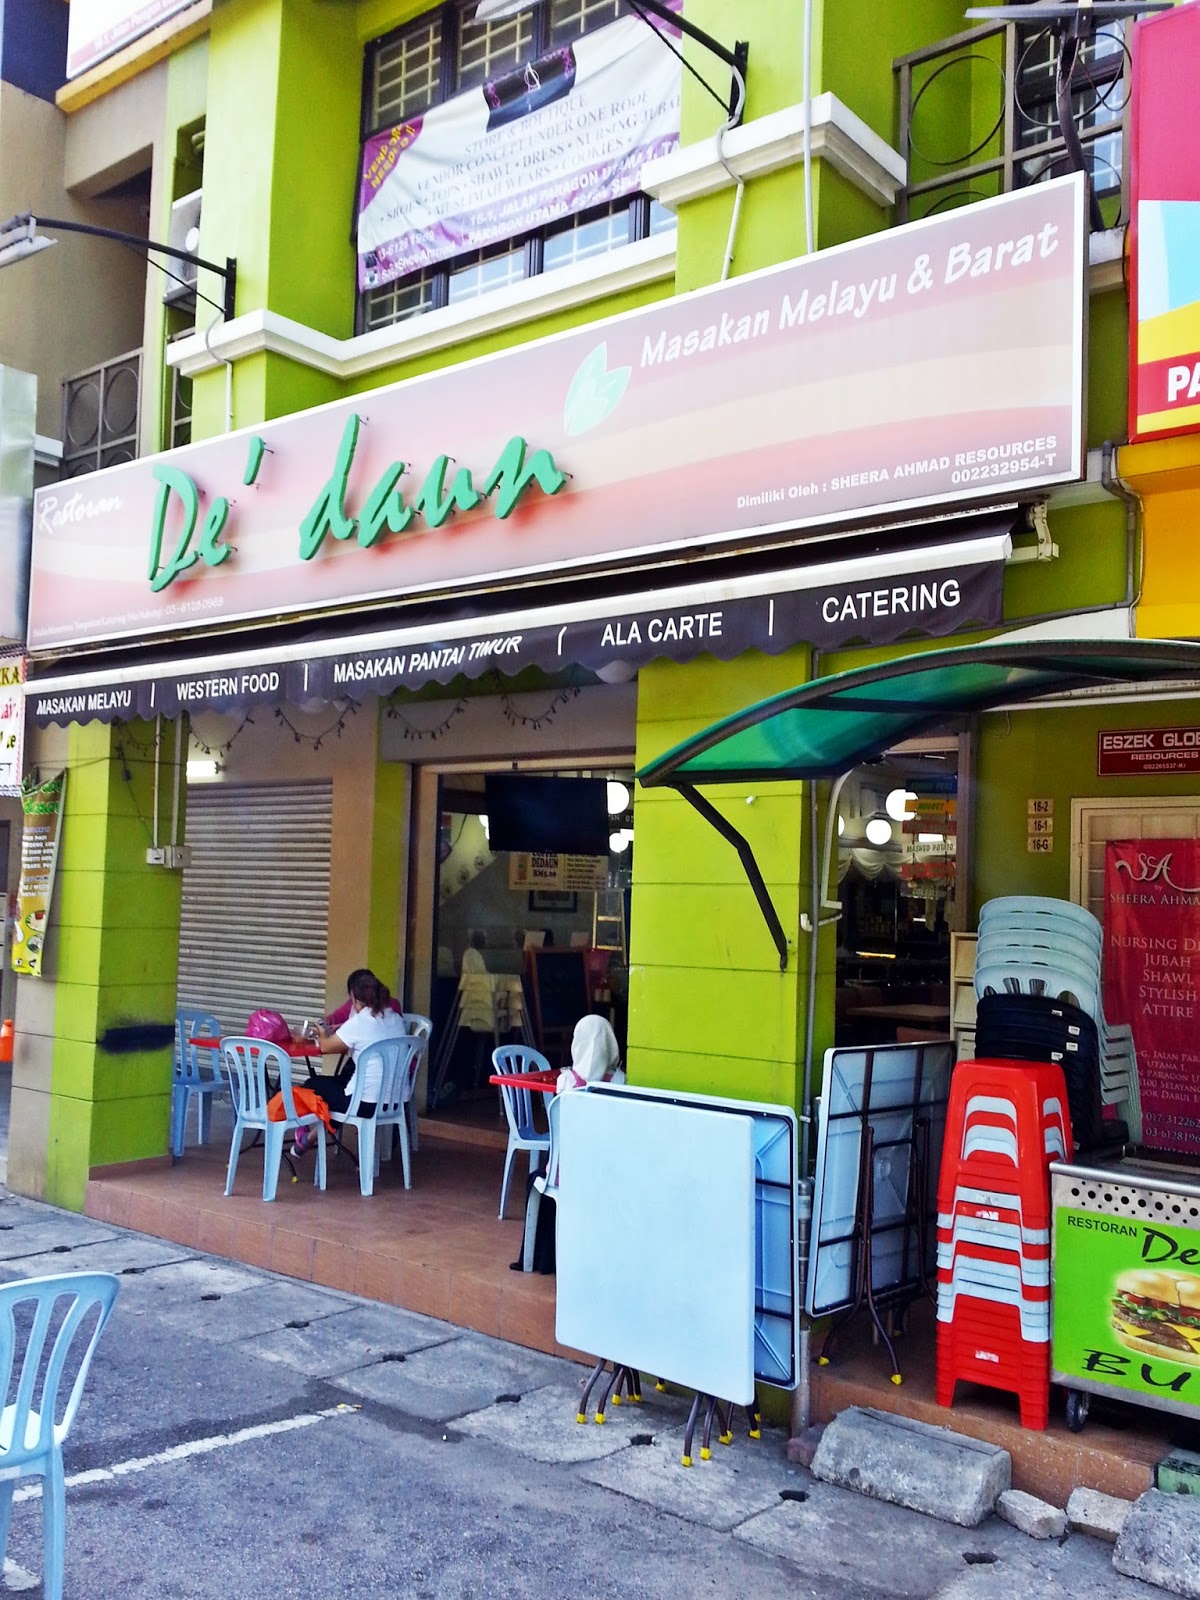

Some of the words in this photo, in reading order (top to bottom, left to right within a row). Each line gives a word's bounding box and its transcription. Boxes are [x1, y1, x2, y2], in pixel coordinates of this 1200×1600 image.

[576, 106, 605, 127] ONE
[611, 90, 648, 116] ROOF
[523, 143, 565, 168] DRESS
[500, 194, 537, 217] JALAN
[526, 200, 568, 225] UTAMA
[641, 309, 769, 367] Masakan
[779, 272, 896, 330] Melayu
[906, 253, 934, 294] &
[944, 222, 1059, 285] Barat
[737, 486, 785, 509] Dimiliki
[788, 479, 819, 501] Oleh
[830, 467, 889, 491] SHEERA
[893, 456, 951, 481] AHMAD
[954, 435, 1058, 468] RESOURCES
[951, 453, 1057, 485] 002232954-T
[300, 413, 566, 560] daun
[822, 579, 961, 623] CATERING
[601, 621, 646, 646] ALA
[648, 612, 723, 643] CARTE
[333, 661, 405, 685] MASAKAN
[407, 650, 466, 674] PANTAI
[467, 634, 523, 662] TIMUR
[176, 676, 239, 702] WESTERN
[241, 672, 280, 694] FOOD
[36, 694, 86, 716] MASAKAN
[88, 689, 132, 711] MELAYU
[1103, 734, 1154, 750] ESZEK
[1131, 751, 1199, 761] RESOURCES
[1033, 801, 1049, 812] 16-2
[1033, 820, 1048, 831] 16-1
[906, 843, 931, 853] MASHED
[932, 842, 953, 852] POTATO
[1032, 839, 1049, 850] 16-G
[1110, 893, 1156, 905] SHEERA
[1110, 935, 1177, 950] NURSING
[1144, 952, 1192, 968] JUBAH
[1143, 969, 1194, 985] SHAWL
[1139, 985, 1197, 1002] STYLISH
[1142, 1003, 1194, 1019] ATTIRE
[1153, 1050, 1179, 1060] JALAN
[1147, 1060, 1178, 1070] UTAMA
[1147, 1069, 1189, 1081] PARAGON
[1067, 1215, 1138, 1238] RESTORAN
